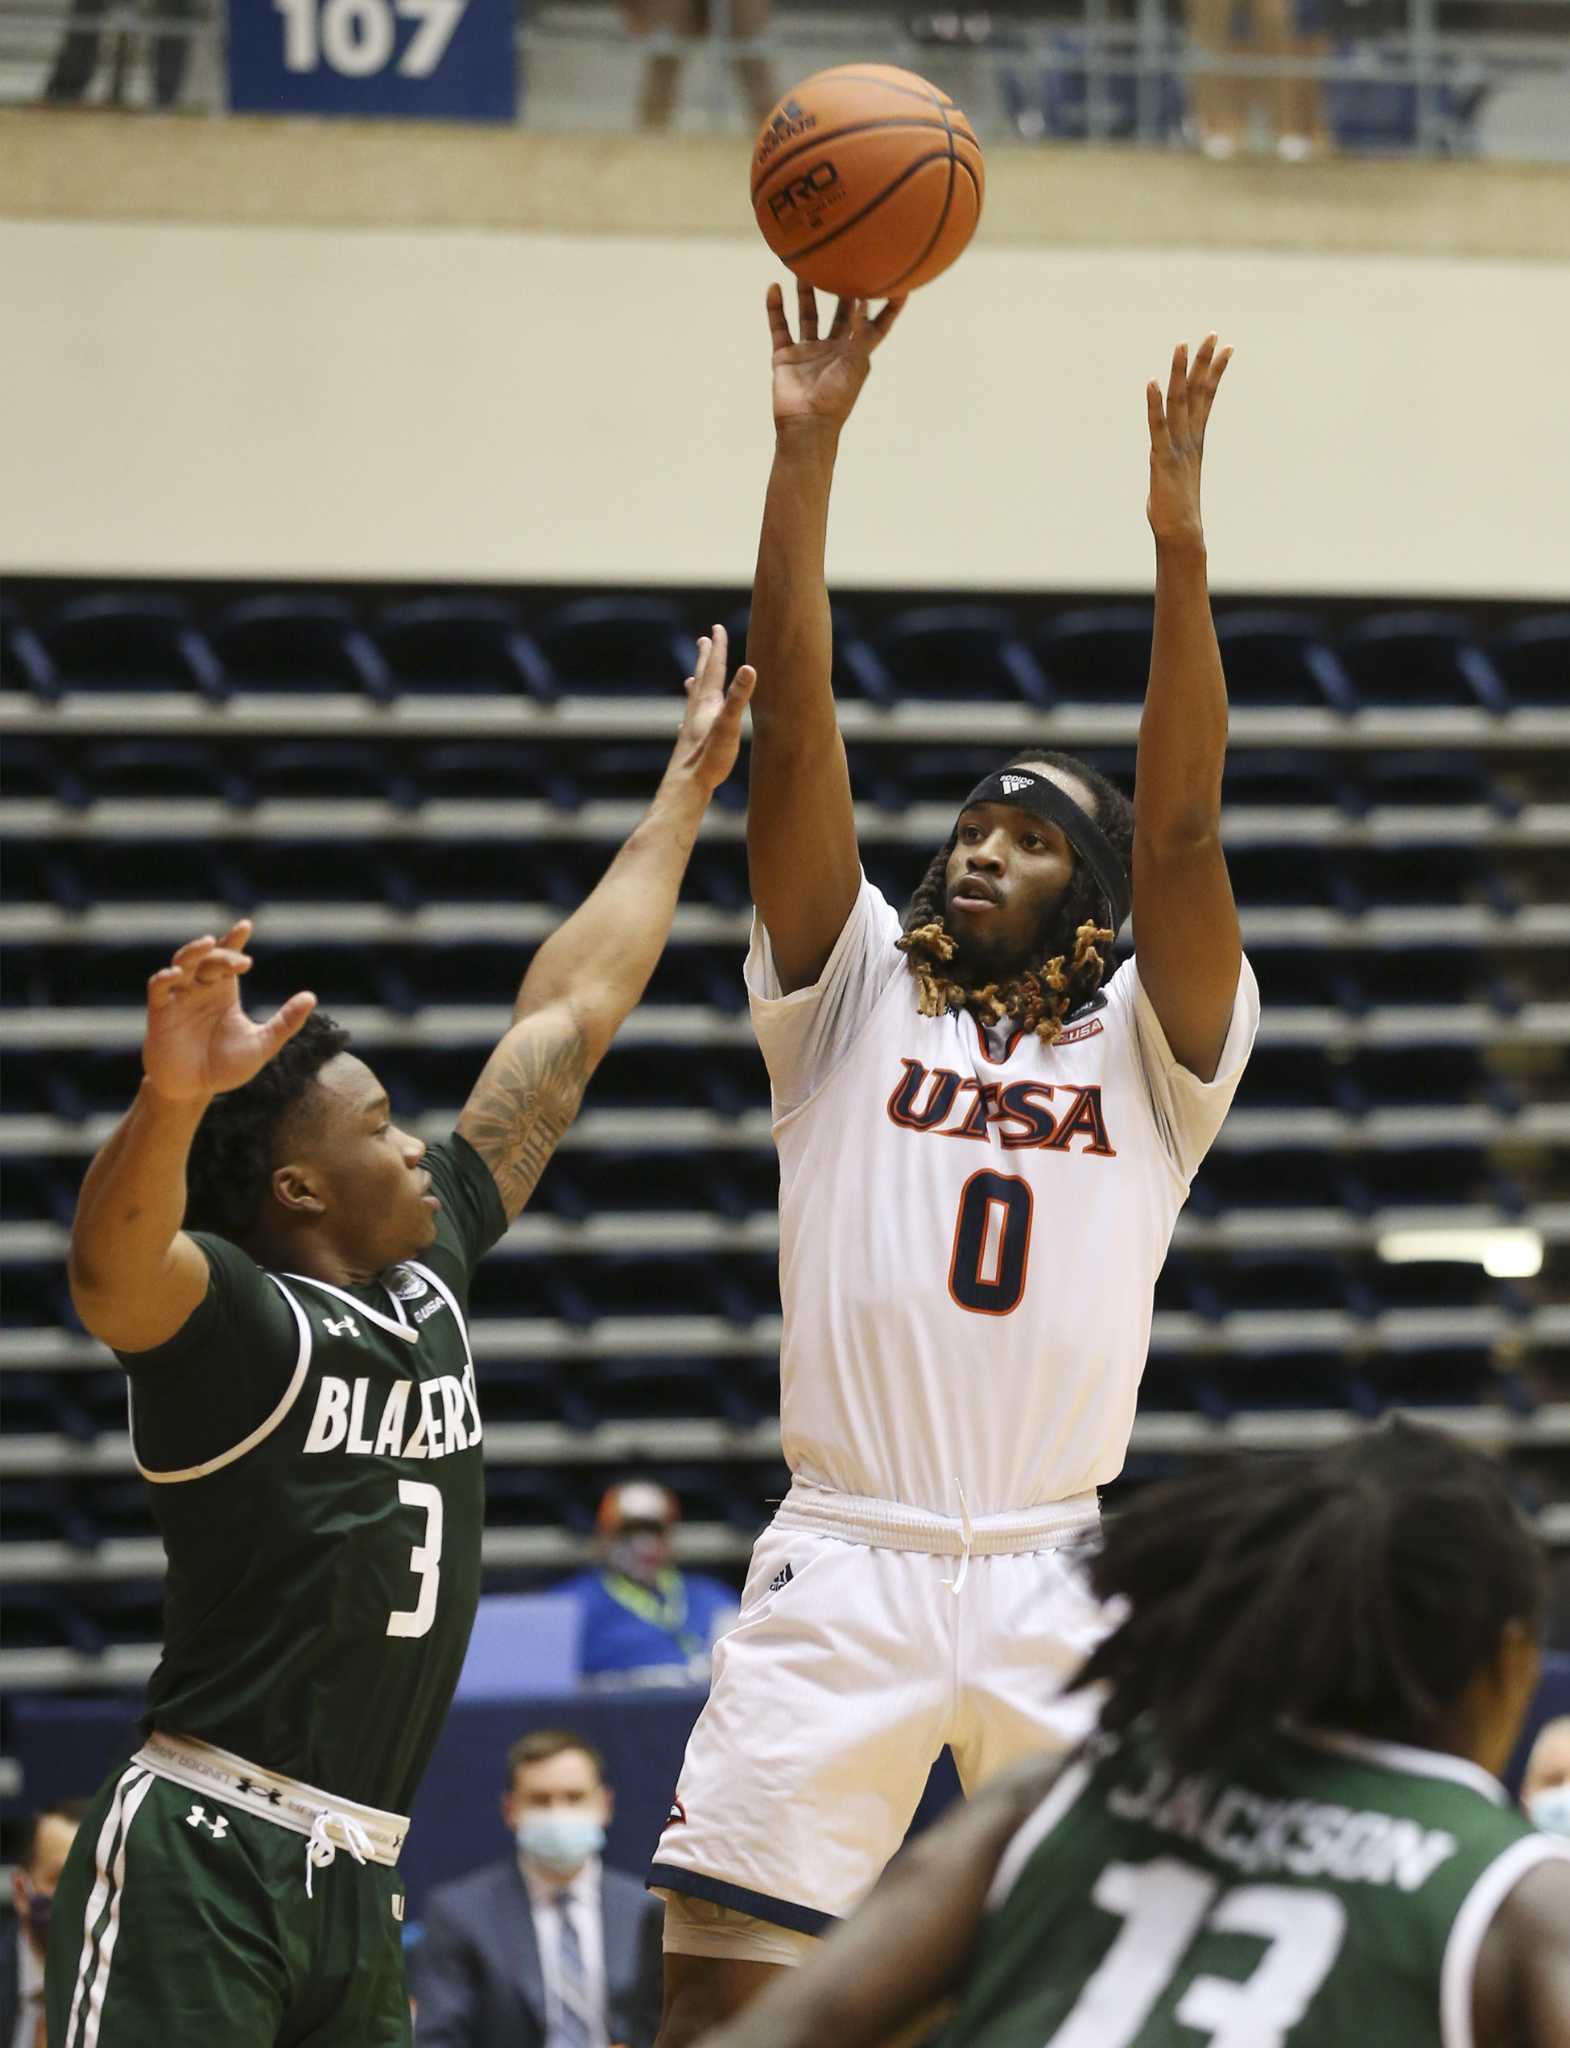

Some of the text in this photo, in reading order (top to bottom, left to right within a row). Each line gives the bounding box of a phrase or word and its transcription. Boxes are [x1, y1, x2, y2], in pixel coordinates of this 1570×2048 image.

[273, 0, 470, 78] 107
[767, 160, 838, 225] PRO
[887, 1057, 1117, 1157] UTSA
[948, 1167, 1034, 1316] 0
[386, 1479, 443, 1638] 3
[1106, 1763, 1457, 1892] JACKSON
[1044, 1857, 1347, 2048] 13
